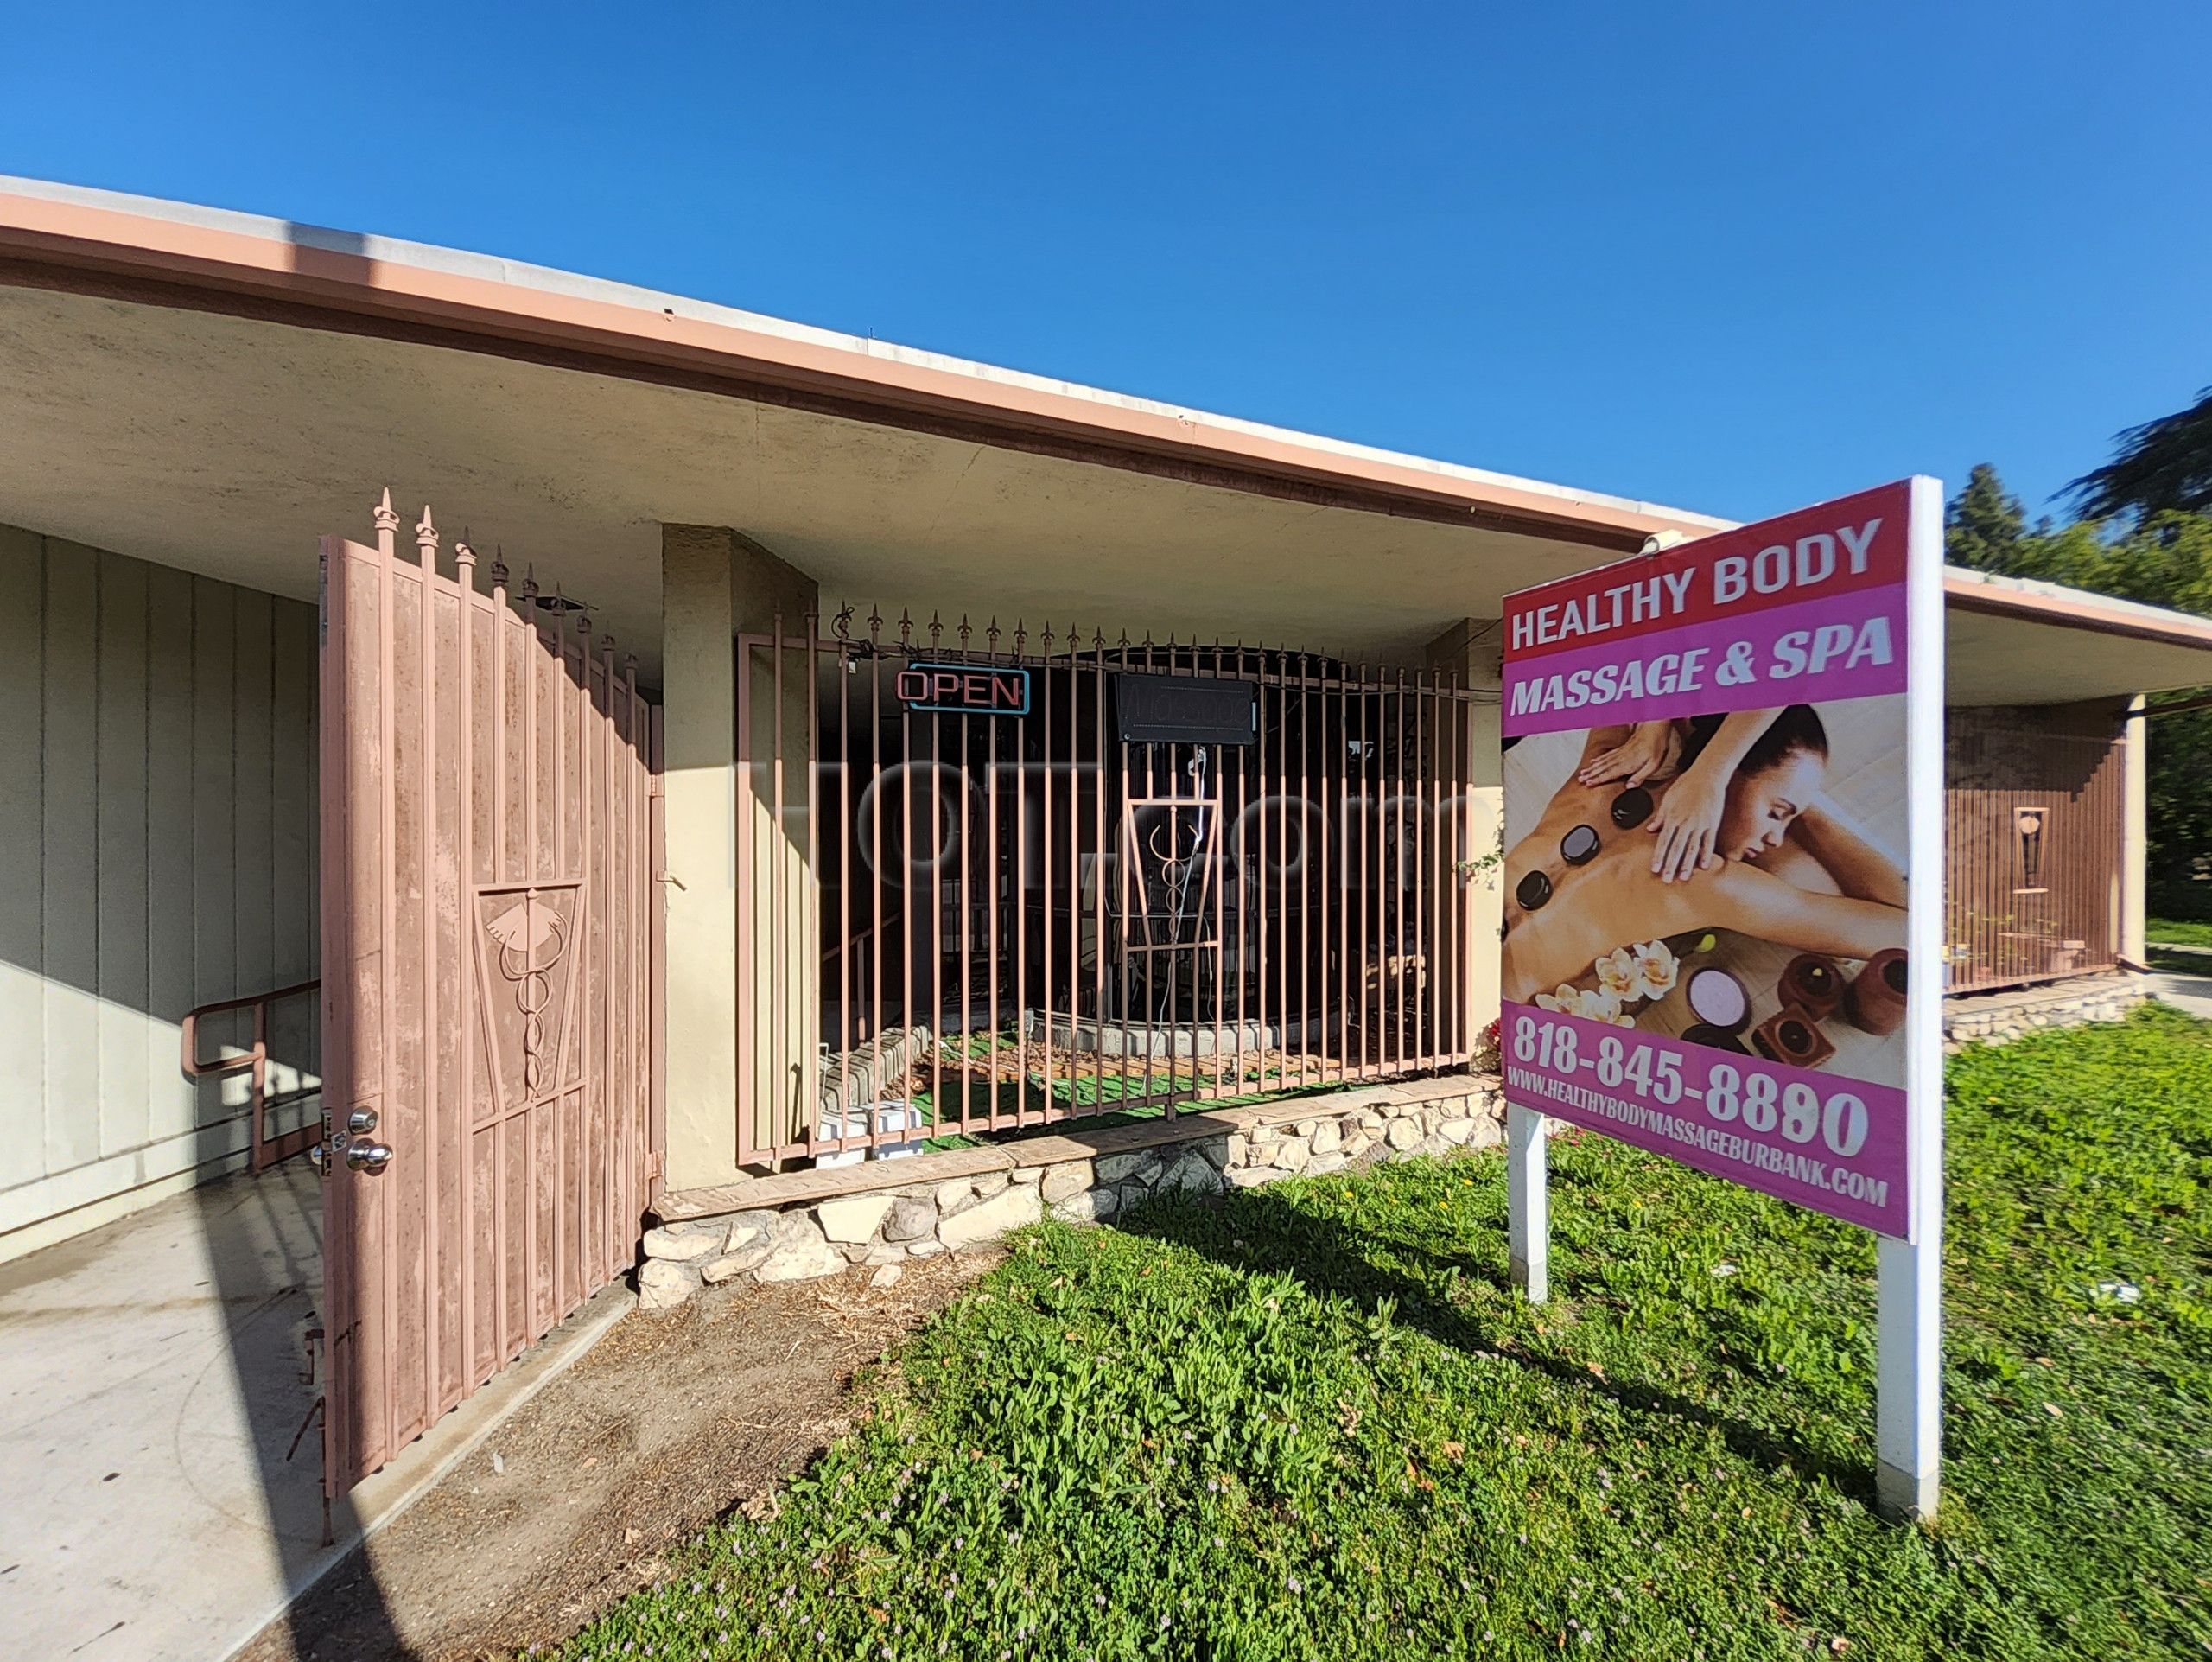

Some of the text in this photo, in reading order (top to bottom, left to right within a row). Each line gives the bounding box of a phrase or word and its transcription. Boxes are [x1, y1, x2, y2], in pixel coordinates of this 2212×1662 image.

[1511, 518, 1884, 651] HEALTHY BODY
[896, 671, 1020, 706] OPEN
[1510, 615, 1894, 717] MASSAGE & SPA
[1507, 1066, 1889, 1208] WWW.HEALTHYBODYMASSAGEBURBANK.COM
